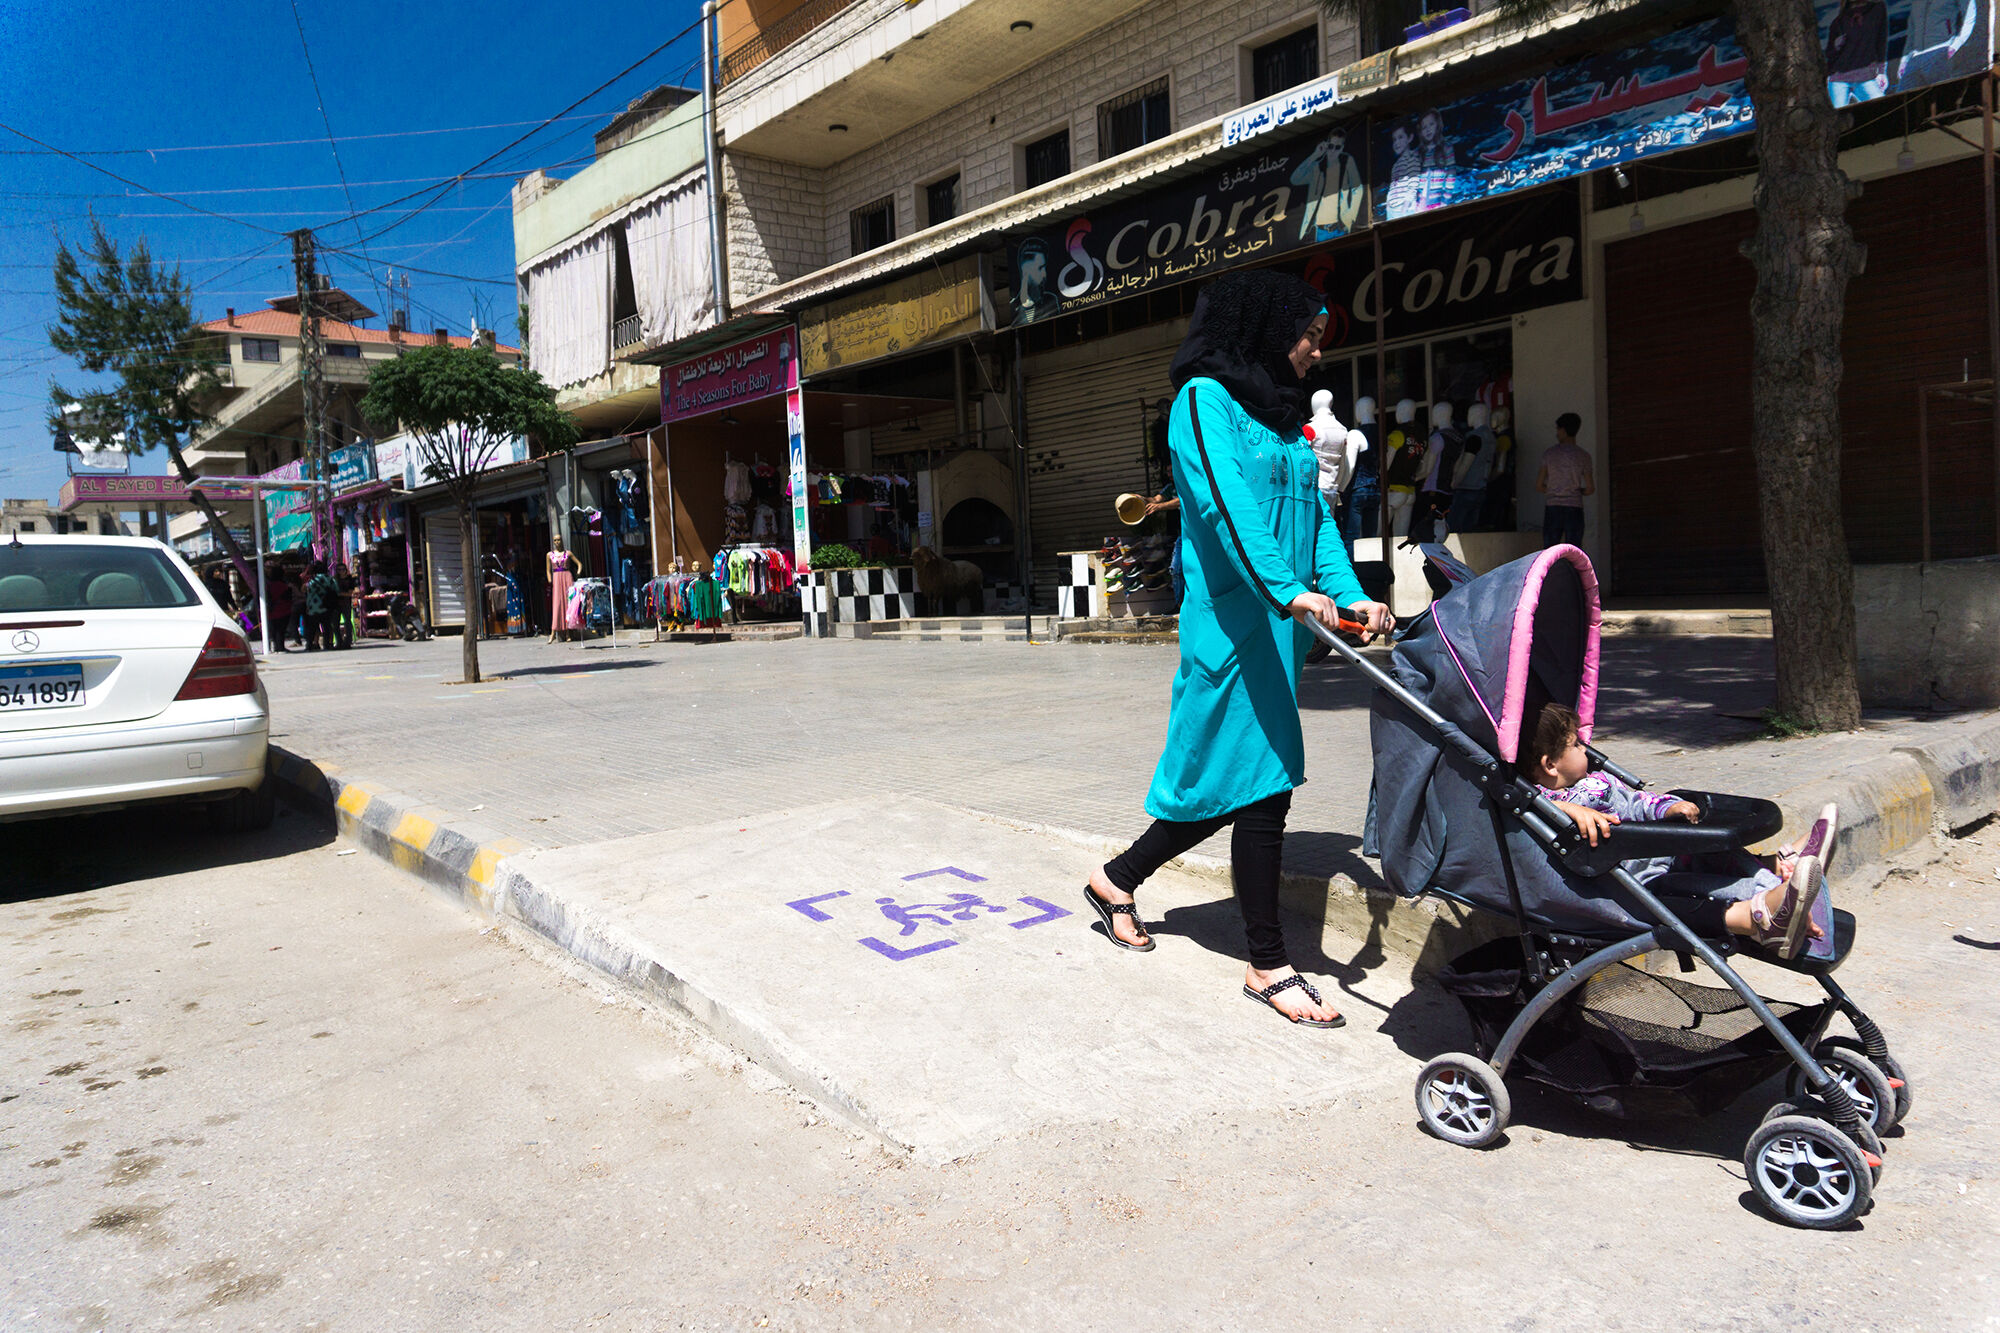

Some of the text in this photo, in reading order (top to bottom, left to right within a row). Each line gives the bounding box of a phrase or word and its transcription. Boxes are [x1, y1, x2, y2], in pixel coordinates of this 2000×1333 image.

[1301, 87, 1334, 115] محمود
[1480, 45, 1748, 163] يسار
[1635, 128, 1672, 154] ولادي
[1529, 155, 1565, 179] تجهيز
[1581, 144, 1621, 168] رجالي
[1218, 155, 1290, 192] جملة ومفرق
[1105, 185, 1292, 270] Cobra
[1106, 226, 1274, 295] أحدث الألبسة الرجالية
[1351, 235, 1575, 323] Cobra
[1061, 291, 1106, 311] 70/796801
[736, 341, 769, 369] الفصول
[676, 394, 690, 410] The
[698, 386, 730, 406] Seasons
[731, 379, 747, 396] For
[748, 370, 773, 393] Baby
[80, 480, 101, 492] AL
[106, 480, 156, 492] SAYED
[0, 680, 80, 707] 641897
